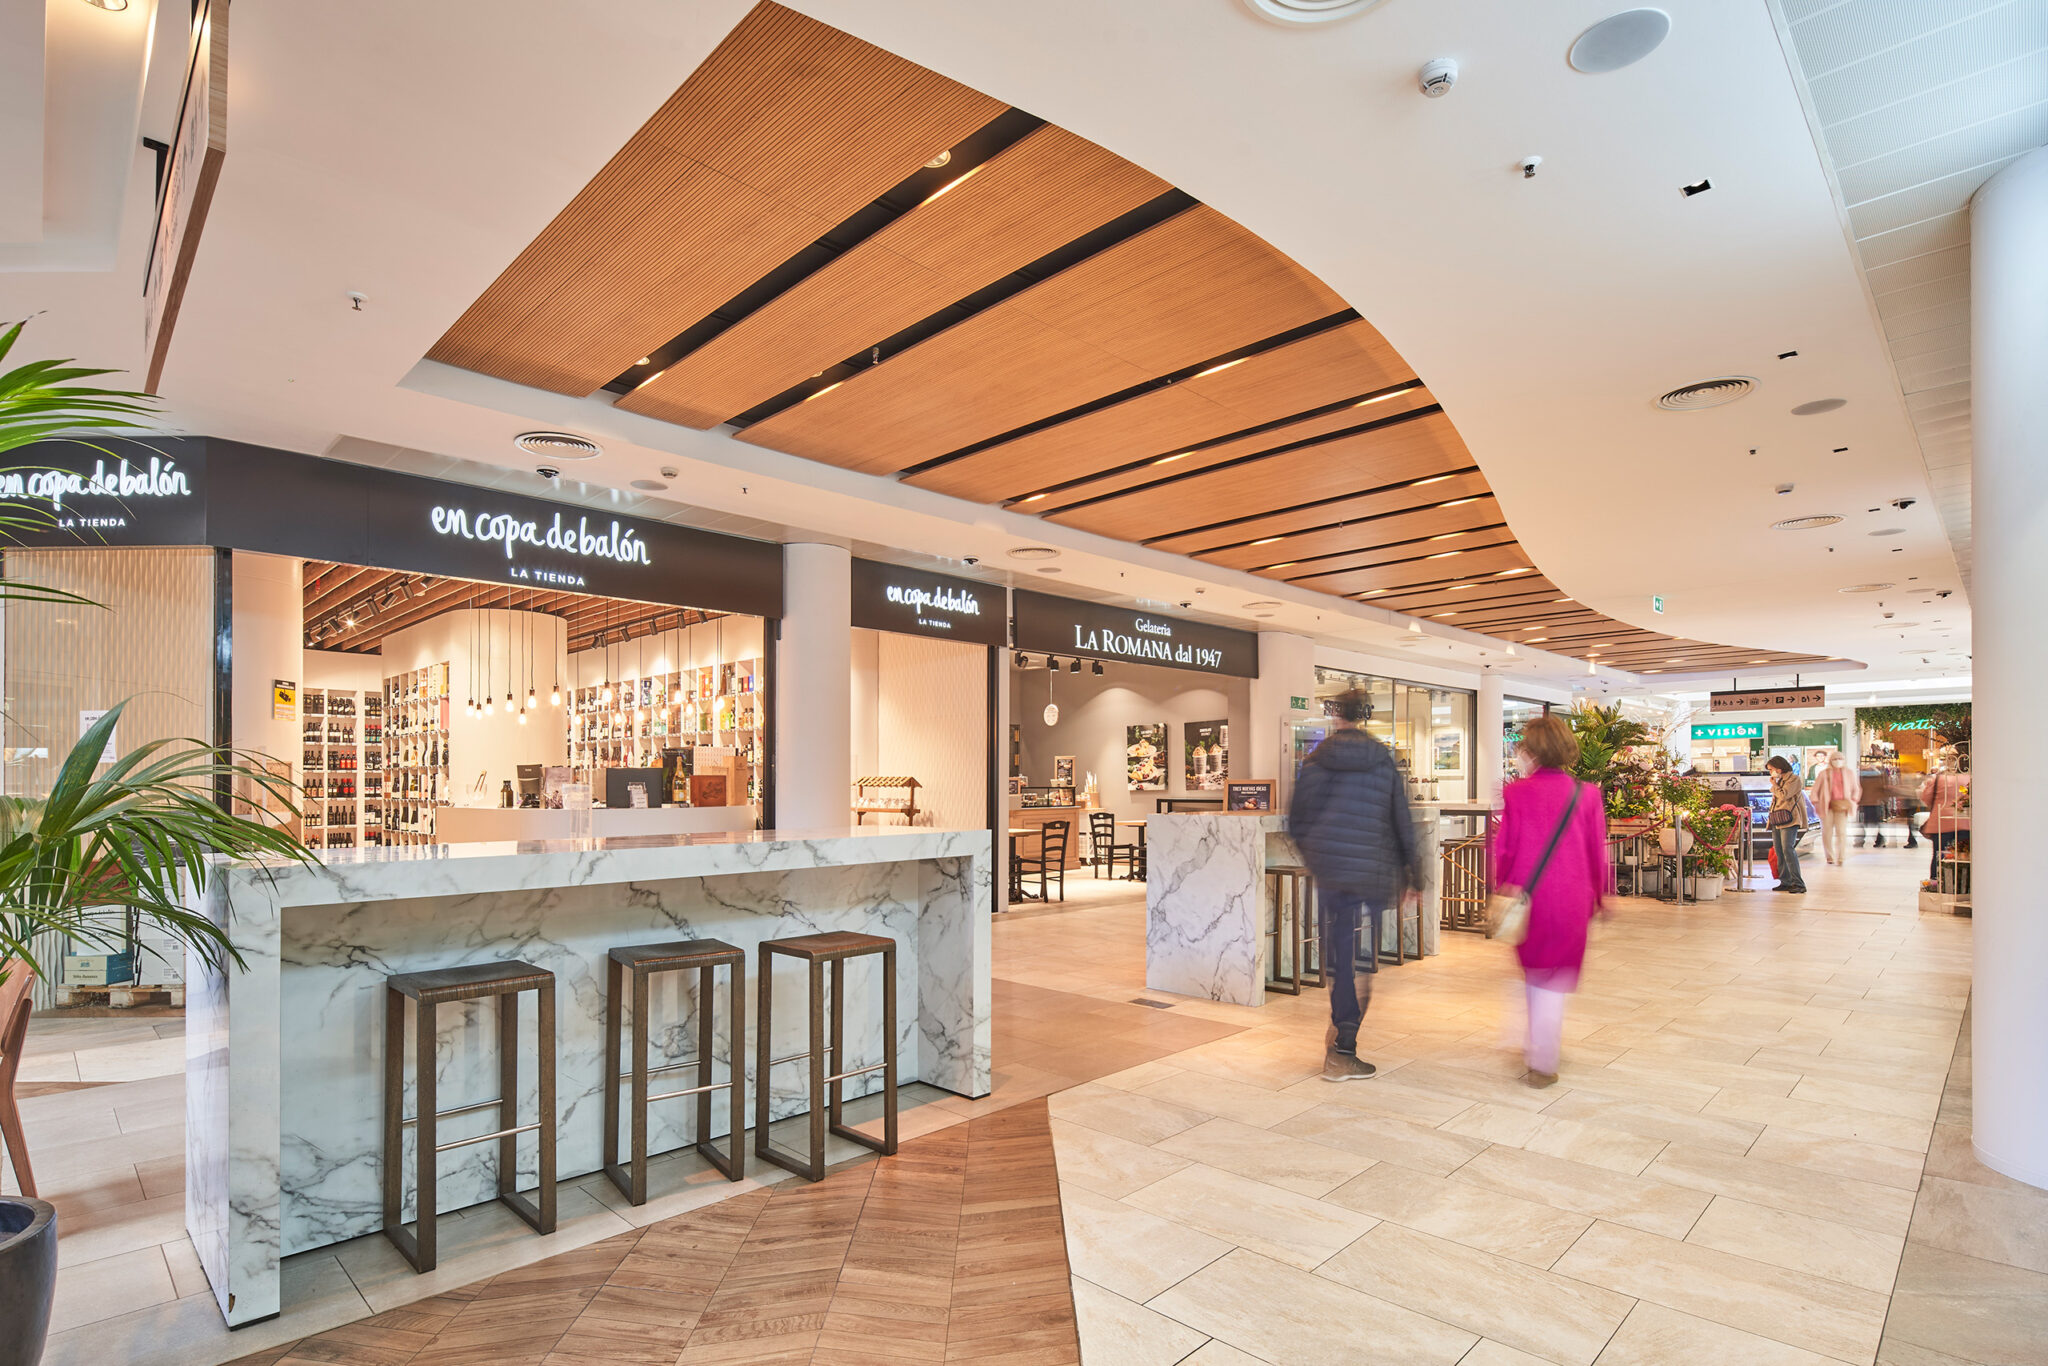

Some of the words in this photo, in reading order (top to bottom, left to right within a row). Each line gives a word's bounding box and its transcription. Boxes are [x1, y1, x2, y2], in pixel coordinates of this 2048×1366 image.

[58, 518, 75, 528] LA
[79, 517, 126, 527] TIENDA
[431, 506, 474, 539] en
[475, 513, 546, 559] copa
[510, 567, 529, 579] LA
[534, 570, 585, 587] TIENDA
[886, 585, 905, 604] en
[904, 588, 934, 615] copa
[918, 618, 928, 626] LA
[929, 620, 951, 629] TIENDA
[1135, 618, 1171, 636] Gelateria
[1074, 624, 1100, 651] LA
[1102, 629, 1172, 661] ROMANA
[1175, 643, 1193, 664] dal
[1195, 647, 1223, 669] 1947
[1707, 725, 1757, 736] VISIÓN
